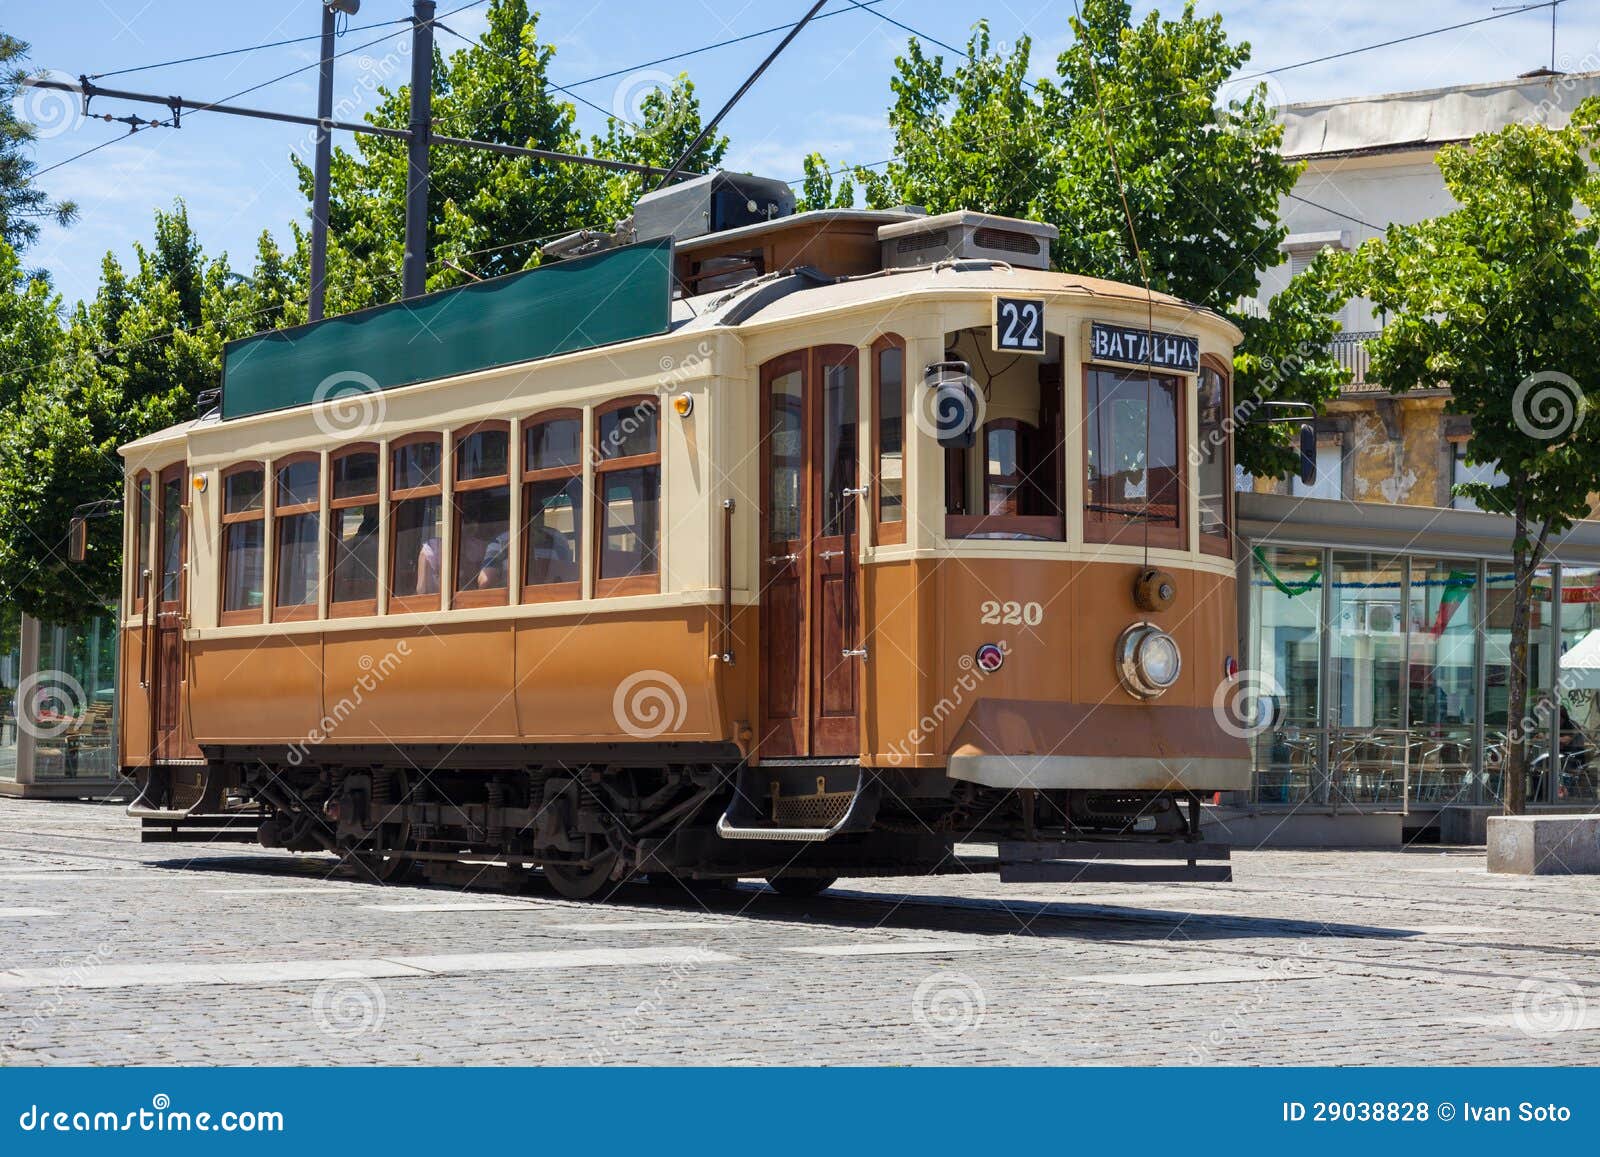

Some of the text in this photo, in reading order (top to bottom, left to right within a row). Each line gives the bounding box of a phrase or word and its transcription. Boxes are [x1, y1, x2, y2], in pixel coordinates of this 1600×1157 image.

[1001, 302, 1039, 347] 22
[1095, 329, 1193, 367] BATALHA
[980, 600, 1043, 626] 220
